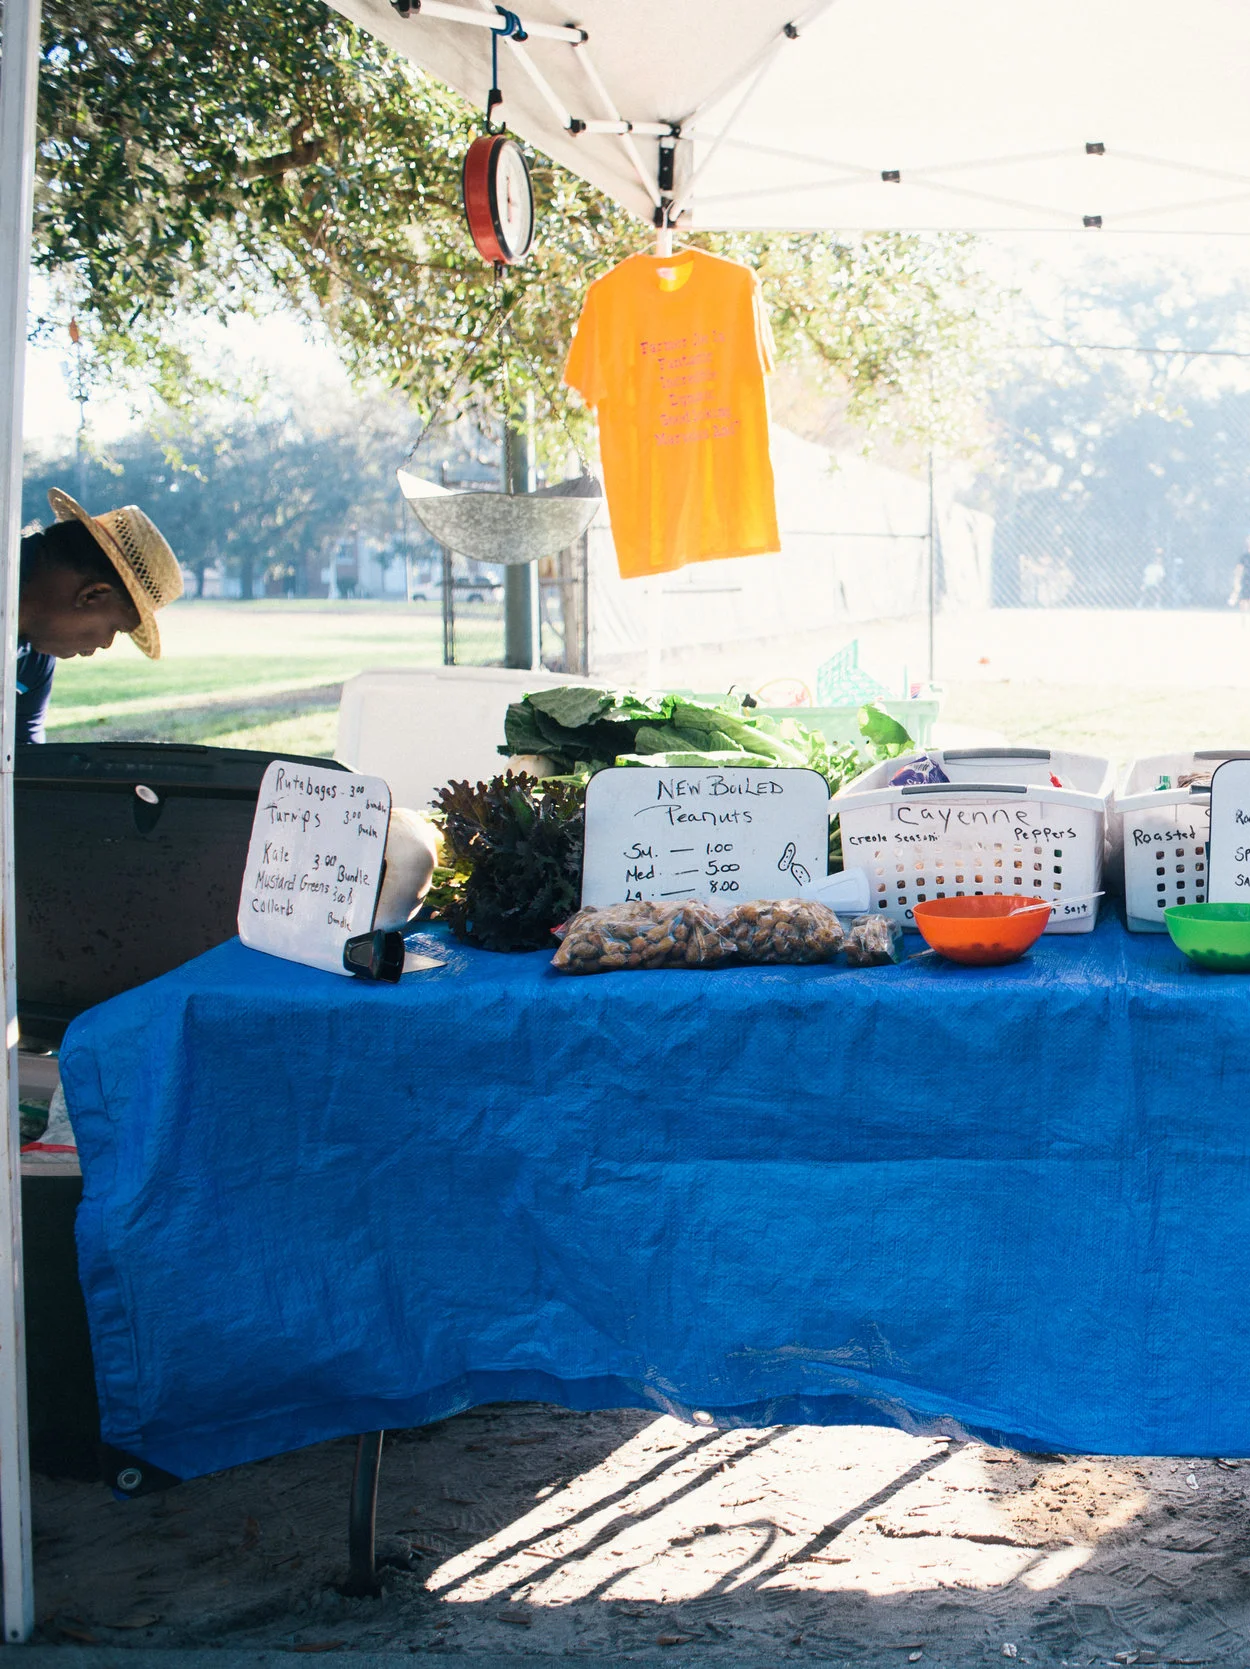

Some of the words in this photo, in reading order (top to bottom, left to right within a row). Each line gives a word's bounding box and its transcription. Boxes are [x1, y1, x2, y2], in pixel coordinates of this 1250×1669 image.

[276, 768, 337, 801] Rutabagas
[657, 779, 700, 800] NEW
[634, 804, 753, 826] Peanuts
[897, 806, 1029, 833] Cayenne
[1014, 827, 1077, 843] Peppers
[1132, 825, 1196, 846] Roasted
[263, 842, 289, 864] Kale
[706, 843, 734, 855] 1.00
[337, 865, 370, 886] Bundle
[705, 860, 740, 875] 5.00
[255, 871, 296, 891] Mustard
[300, 874, 329, 893] Greens
[709, 880, 739, 893] 8.00
[252, 898, 294, 916] Collards
